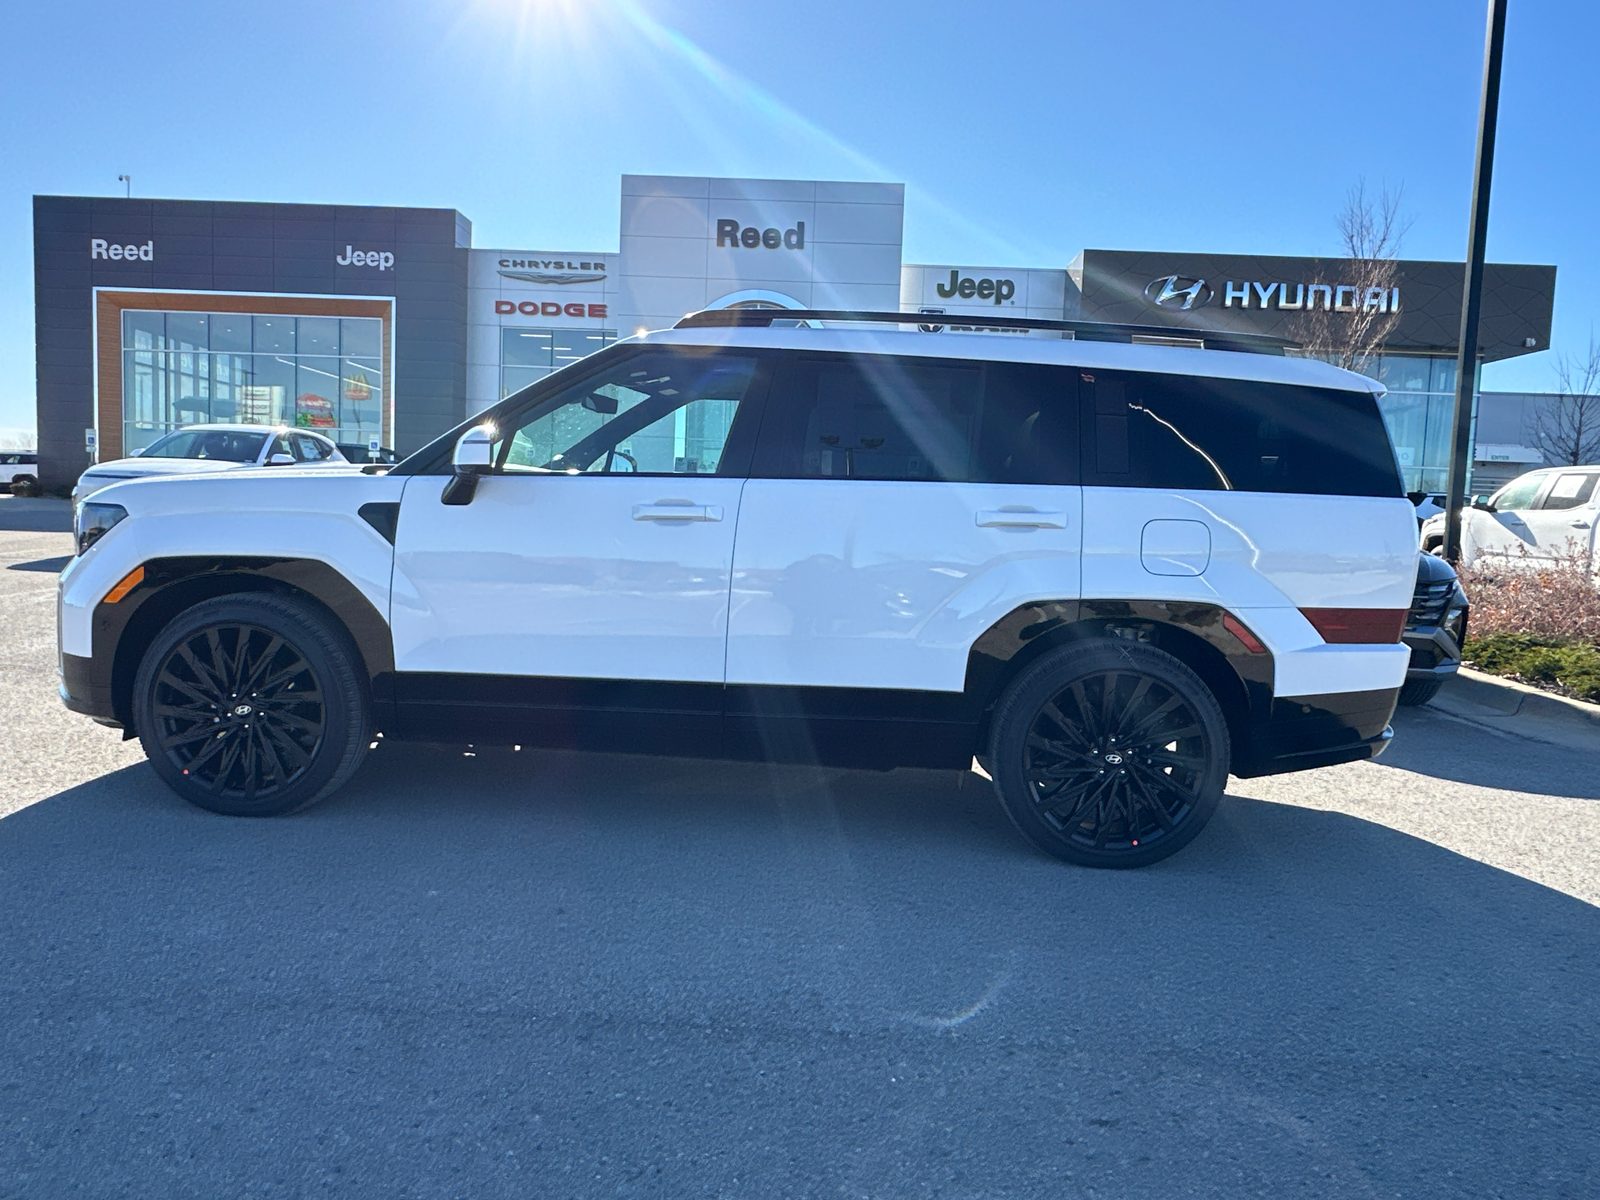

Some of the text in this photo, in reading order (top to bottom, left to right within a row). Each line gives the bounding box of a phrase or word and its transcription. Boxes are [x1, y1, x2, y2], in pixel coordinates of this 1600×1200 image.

[716, 218, 805, 250] Reed
[91, 238, 154, 261] Reed
[336, 245, 395, 271] Jeep
[498, 259, 606, 271] CHRYSLER
[936, 270, 1015, 305] Jeep
[1224, 281, 1399, 314] HYUNDAI
[495, 300, 608, 318] DODGE
